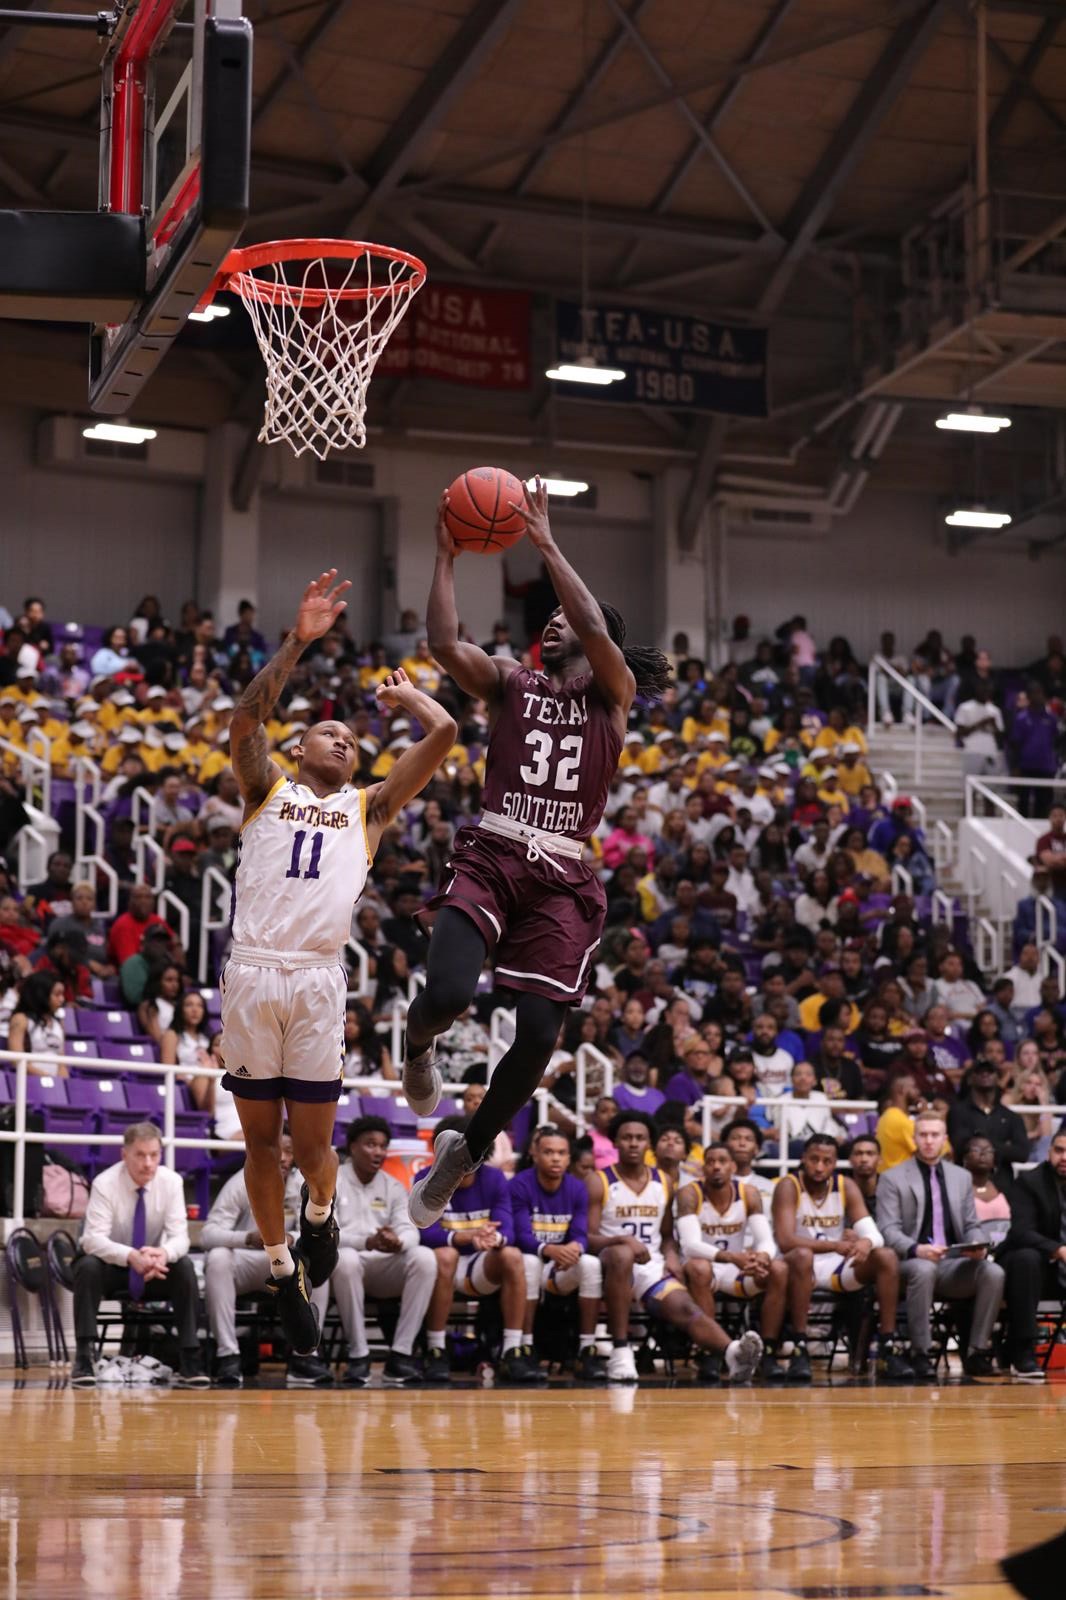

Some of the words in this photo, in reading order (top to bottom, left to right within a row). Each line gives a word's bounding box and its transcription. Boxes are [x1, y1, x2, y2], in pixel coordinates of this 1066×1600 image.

[420, 291, 486, 328] USA
[634, 369, 694, 403] 1980
[520, 729, 584, 792] 32
[285, 830, 324, 879] 11
